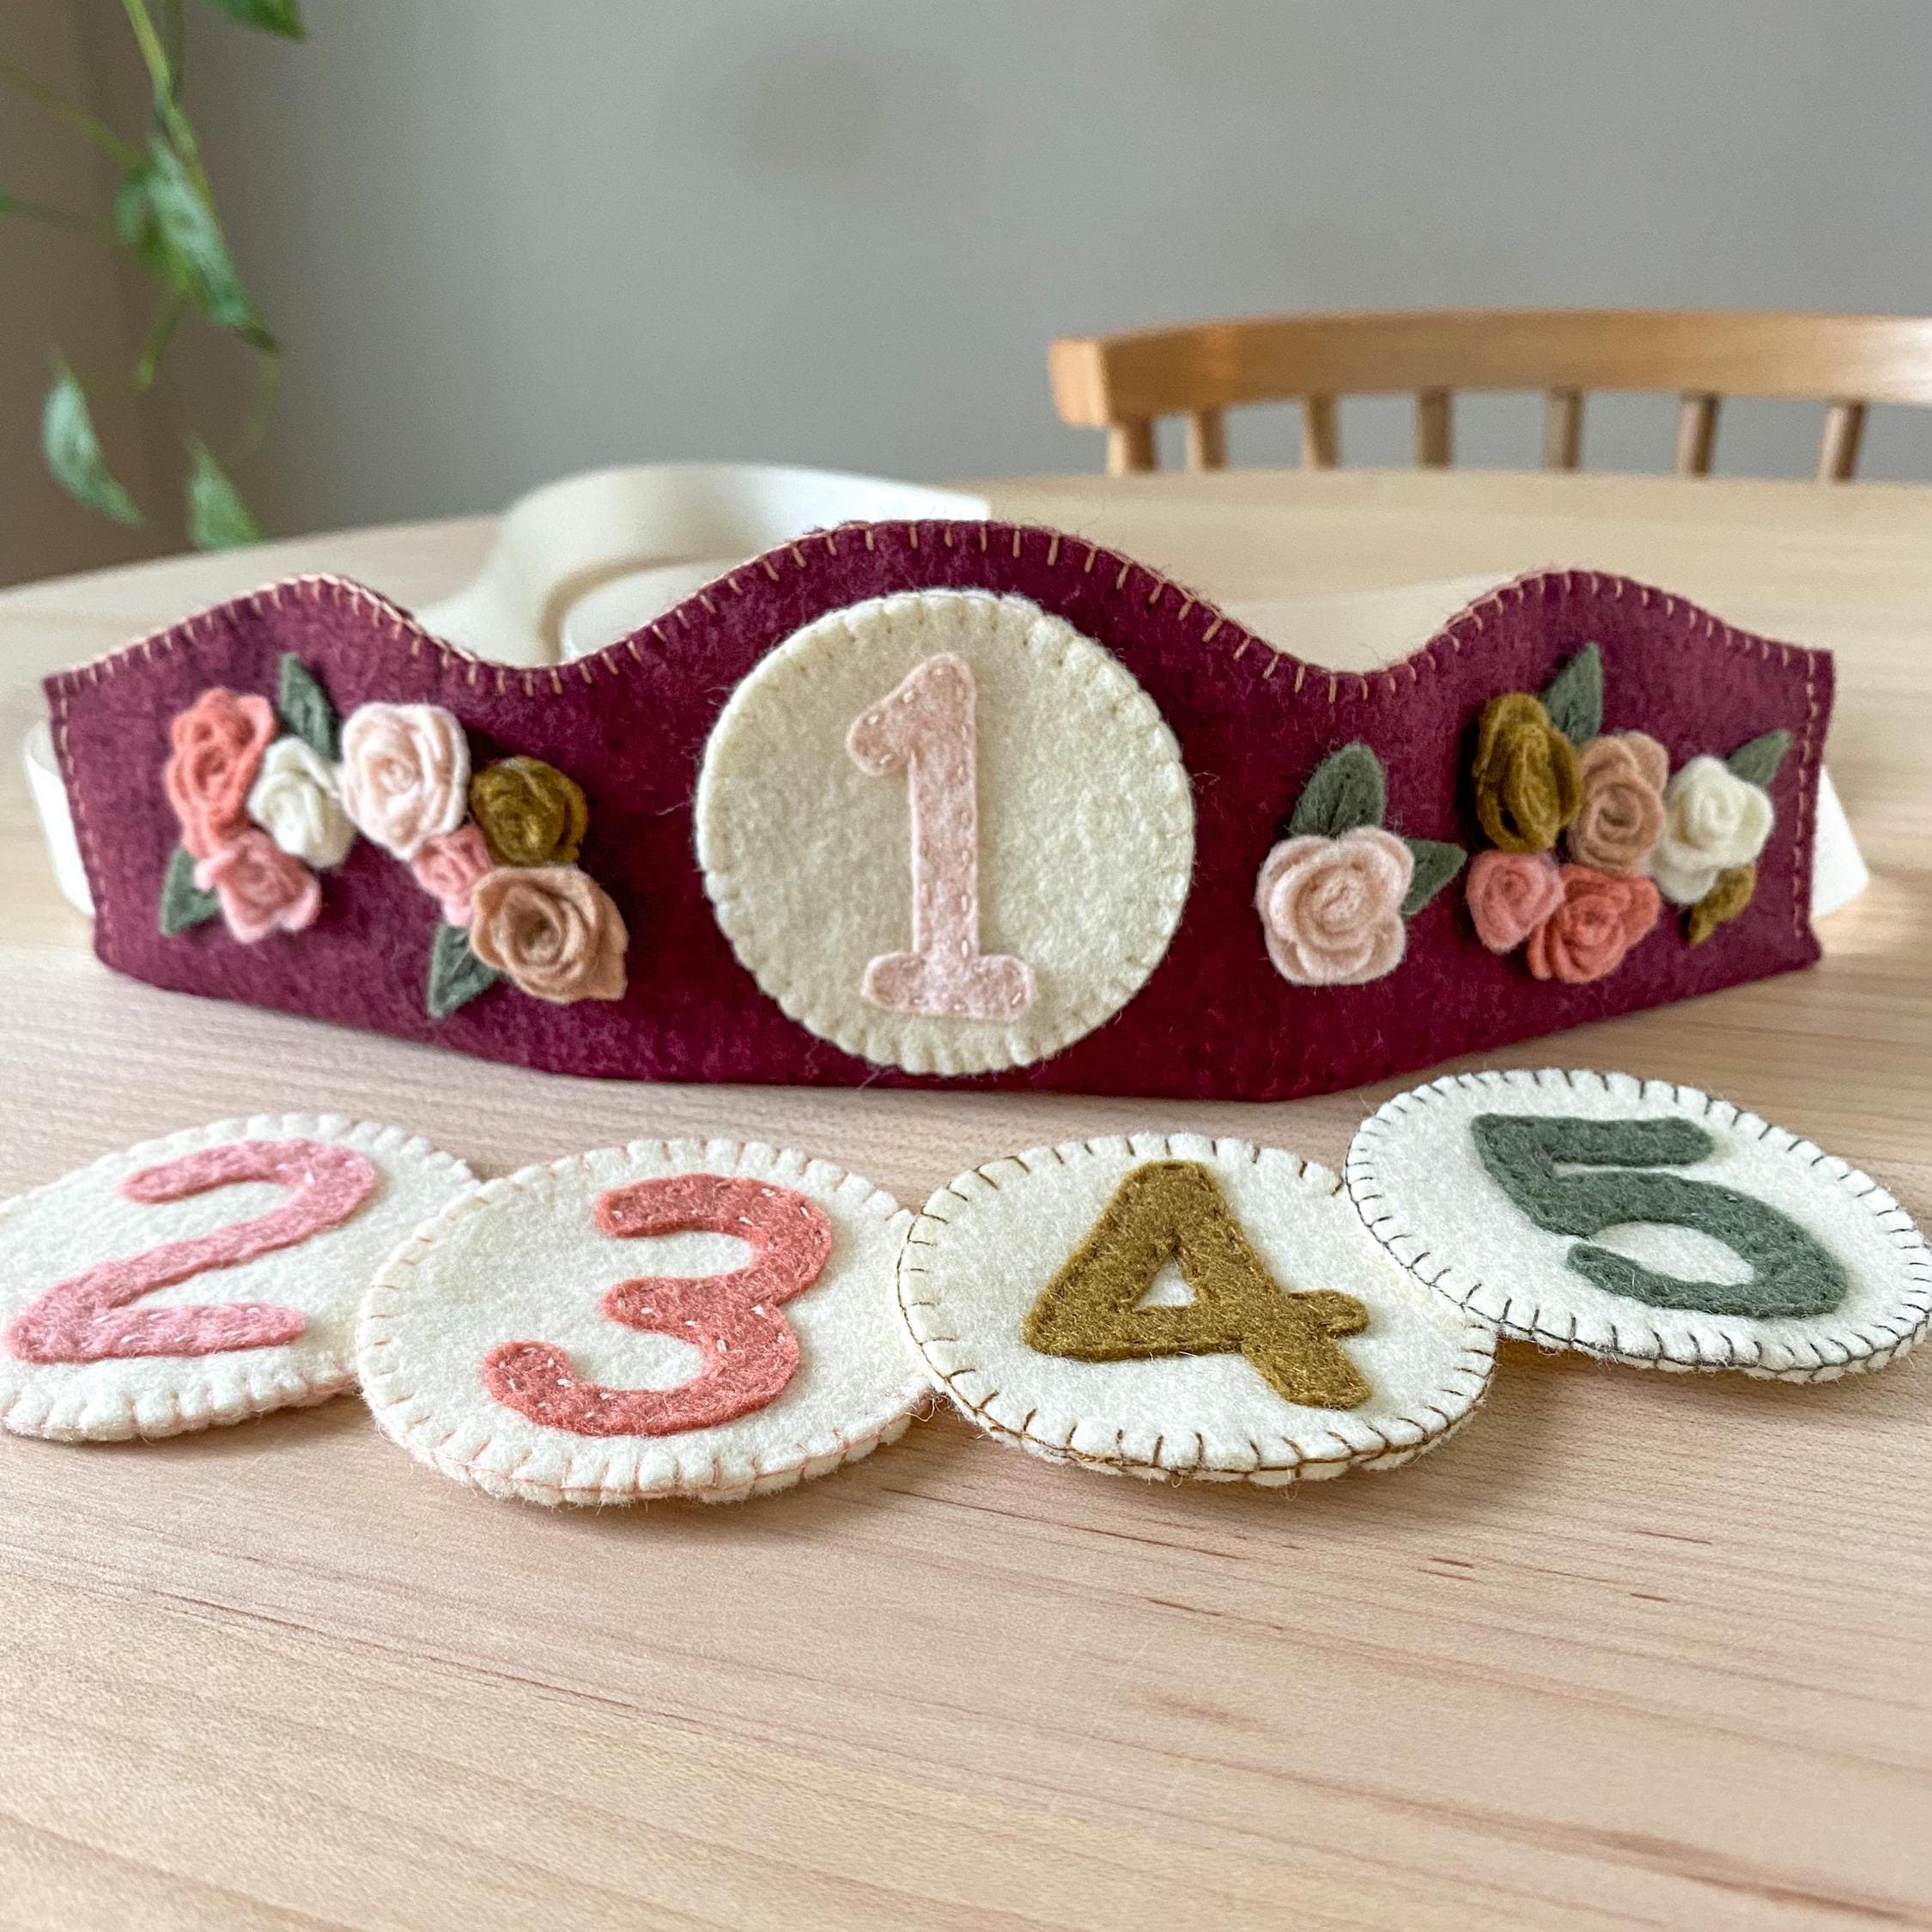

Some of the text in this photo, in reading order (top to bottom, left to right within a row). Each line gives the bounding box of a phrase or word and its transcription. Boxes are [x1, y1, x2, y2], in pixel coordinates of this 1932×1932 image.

[848, 653, 1035, 1020] 1
[8, 1139, 375, 1364] 2
[484, 1172, 832, 1436] 3
[1026, 1159, 1370, 1408] 4
[1473, 1114, 1847, 1318] 5
